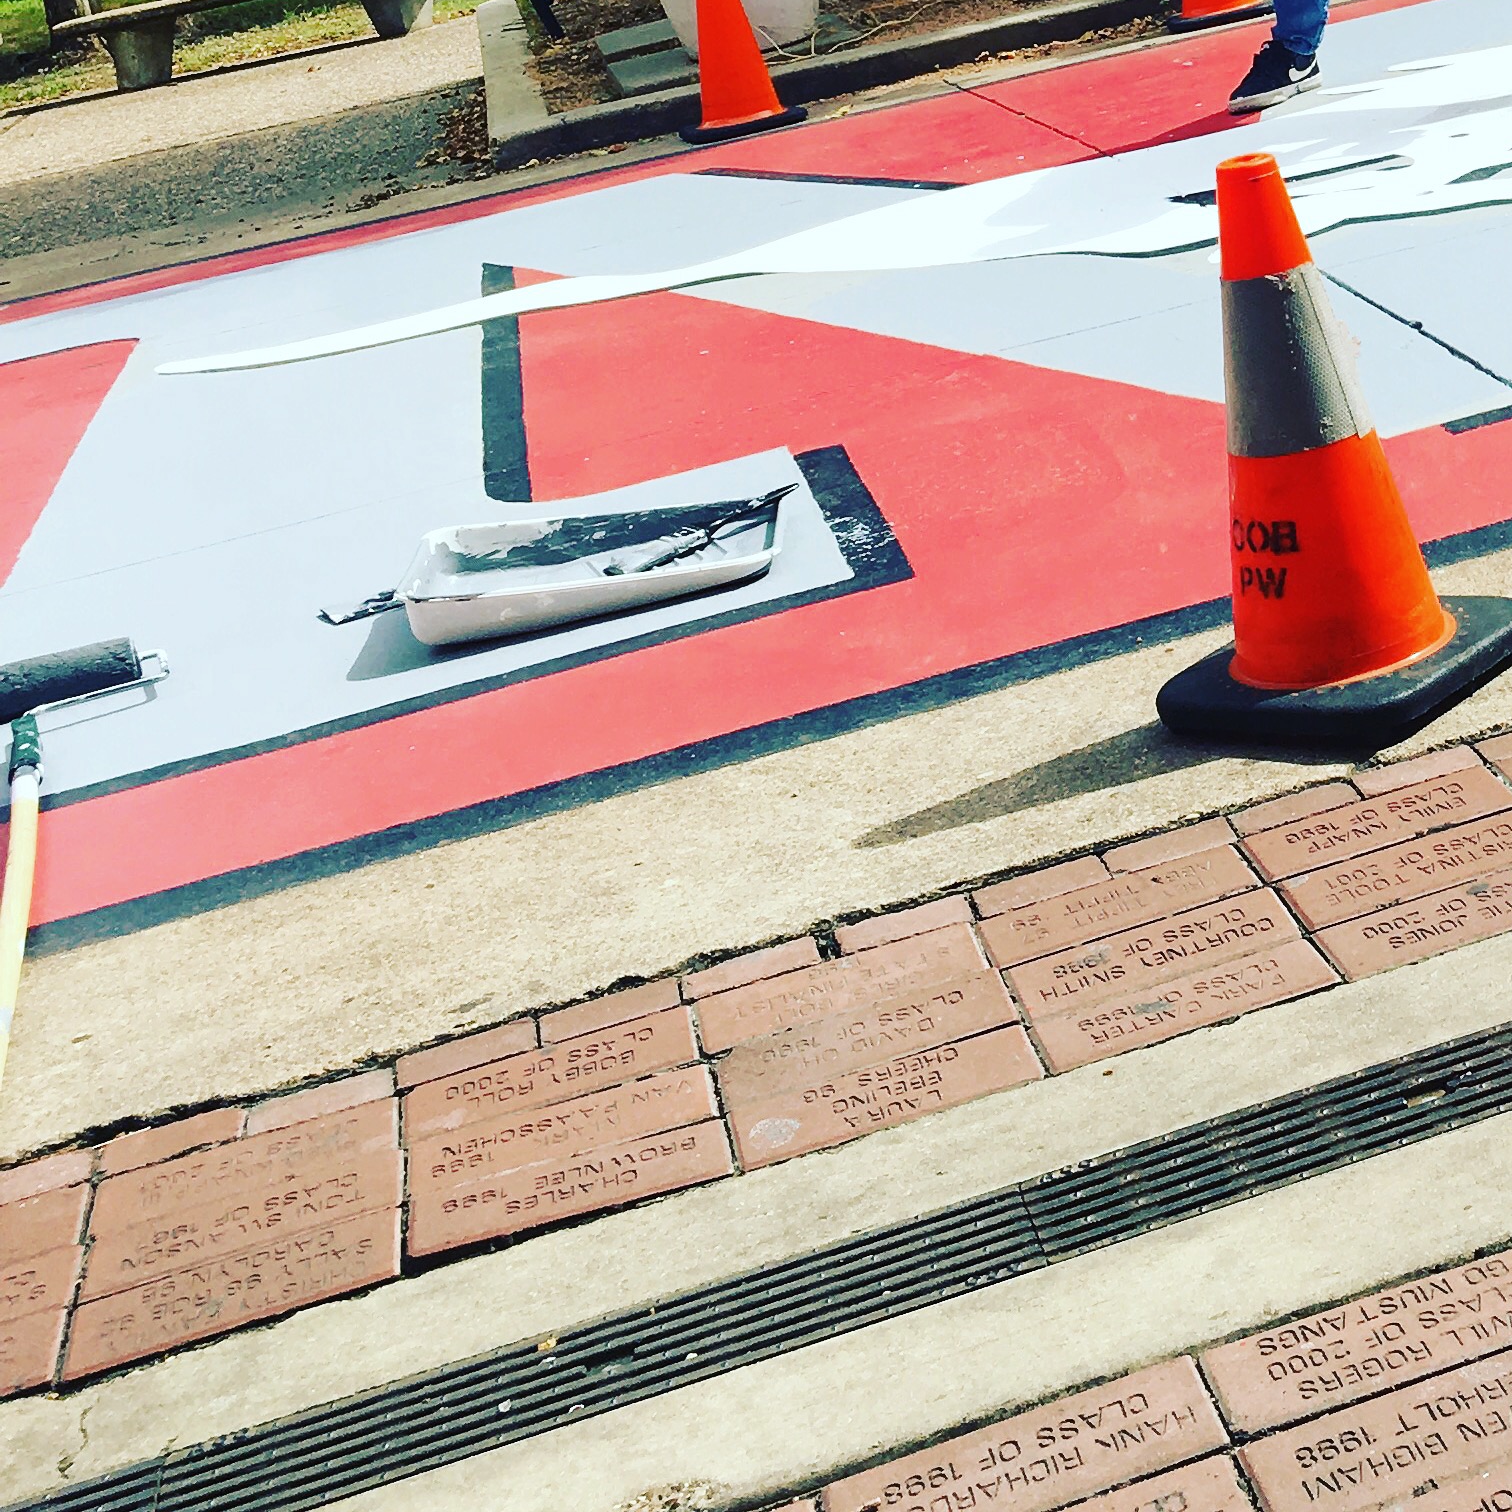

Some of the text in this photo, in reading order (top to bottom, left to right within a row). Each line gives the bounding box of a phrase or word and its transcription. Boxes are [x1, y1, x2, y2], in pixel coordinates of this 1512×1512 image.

[1240, 566, 1288, 600] PW
[1348, 781, 1465, 826] CLASS OF
[1397, 795, 1468, 823] EMILY
[1398, 850, 1425, 869] OF
[1362, 910, 1426, 940] 2000
[1435, 897, 1468, 917] OF
[1122, 907, 1246, 958] CLASS OF
[1388, 913, 1468, 950] JONES
[1038, 916, 1275, 1002] COURTNEY SMITH
[444, 1026, 655, 1101] CLASS OF 2000
[466, 1048, 635, 1104] BOBBY ROLL
[857, 1046, 960, 1088] CHEERS
[842, 1088, 943, 1129] LAURA
[534, 1135, 697, 1191] BROWNLEE
[505, 1168, 639, 1215] CHARLES
[1256, 1258, 1511, 1357] GO MUSTANGS
[1364, 1321, 1407, 1350] OF
[1267, 1338, 1352, 1382] 2000
[1298, 1340, 1433, 1401] ROGERS
[883, 1392, 1150, 1506] CLASS OF 1998
[1093, 1405, 1197, 1453] HANK
[1295, 1425, 1378, 1470] 1998
[1300, 1432, 1449, 1502] BIGHAM
